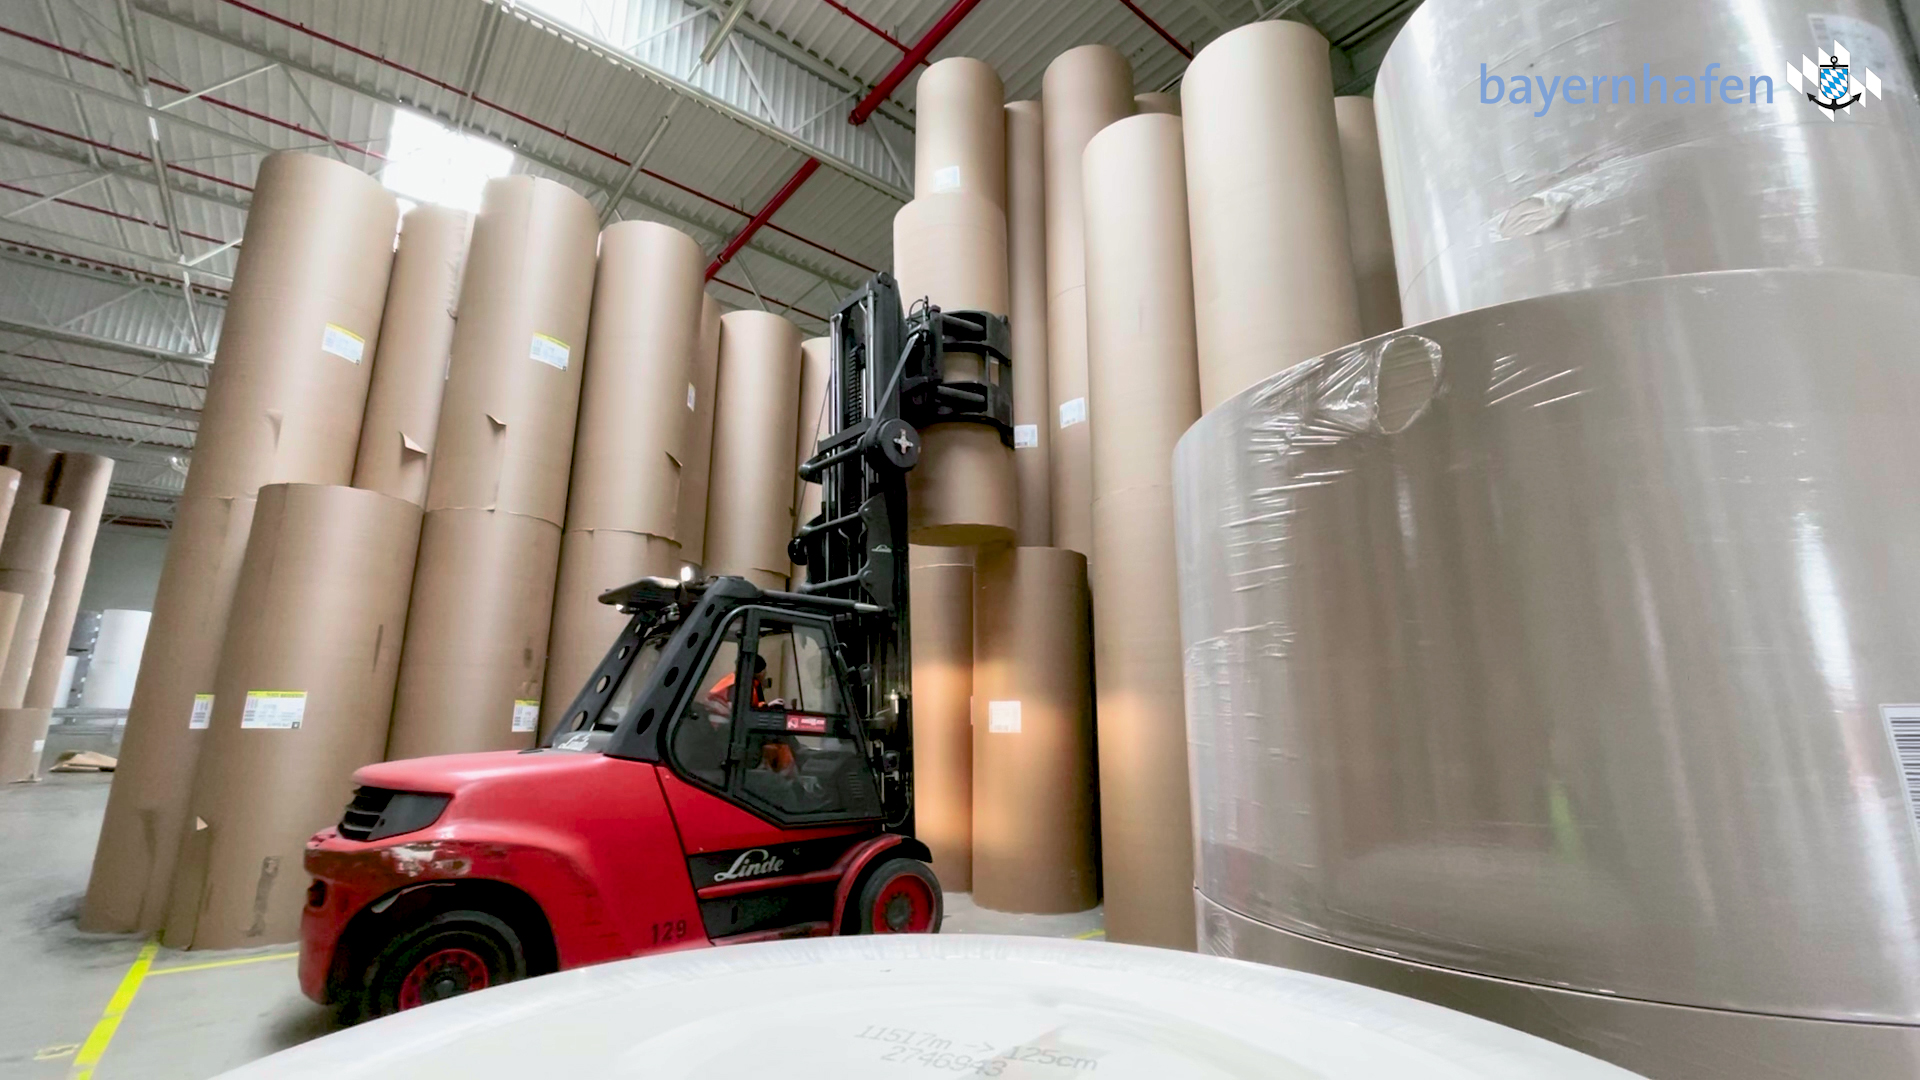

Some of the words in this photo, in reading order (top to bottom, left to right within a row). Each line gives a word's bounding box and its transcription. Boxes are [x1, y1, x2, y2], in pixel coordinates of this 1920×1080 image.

[713, 848, 784, 882] Linde
[652, 920, 687, 944] 129
[1003, 1045, 1098, 1071] 125cm
